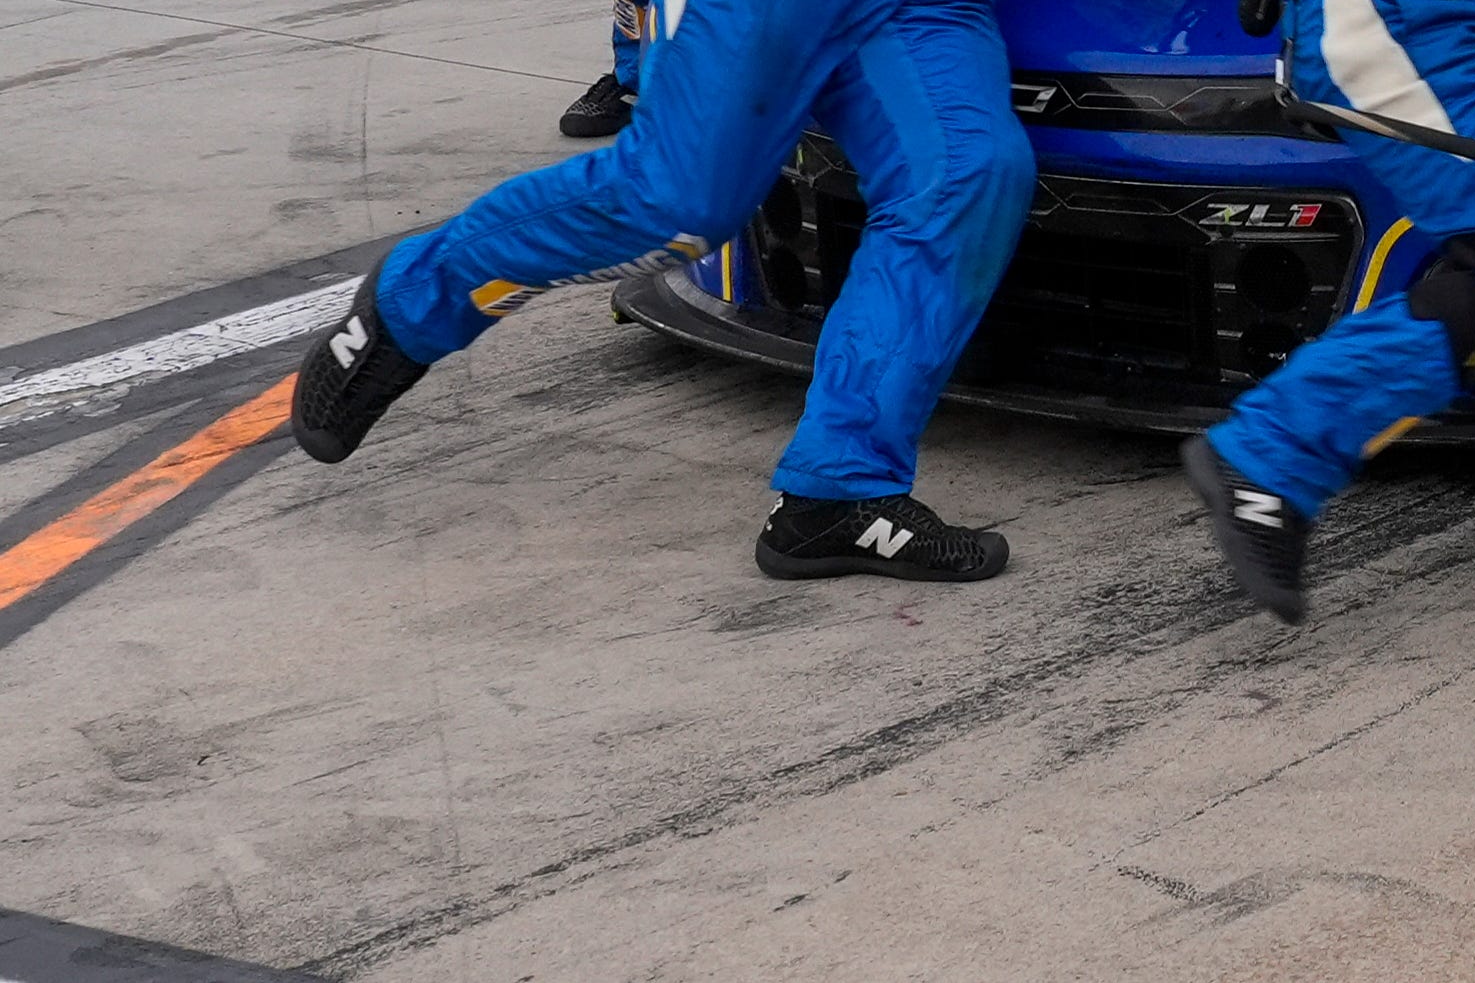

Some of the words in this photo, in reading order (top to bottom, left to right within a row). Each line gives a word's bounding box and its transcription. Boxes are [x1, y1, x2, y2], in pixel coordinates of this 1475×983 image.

[1199, 201, 1322, 228] ZL1
[330, 315, 370, 370] N
[1233, 488, 1283, 529] N
[853, 516, 915, 559] N
